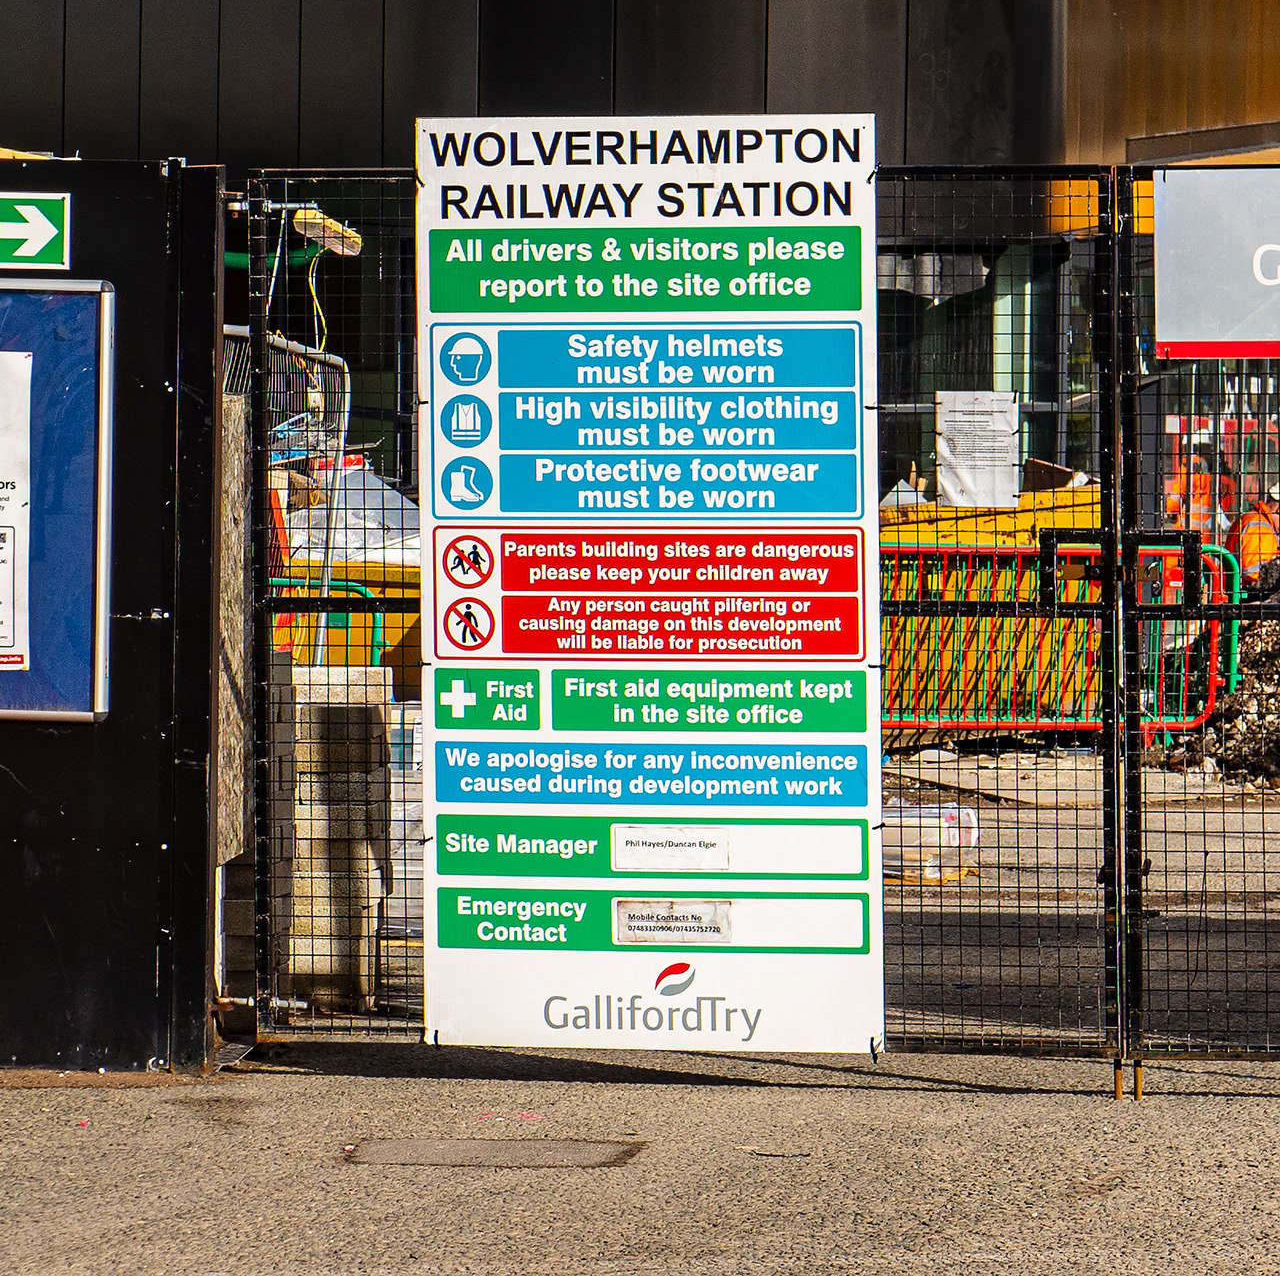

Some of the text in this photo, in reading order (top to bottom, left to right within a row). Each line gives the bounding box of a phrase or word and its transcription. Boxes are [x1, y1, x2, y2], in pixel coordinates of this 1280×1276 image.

[430, 128, 862, 167] WOLVERHAMPTON
[441, 181, 852, 220] RAILWAY STATION
[446, 238, 845, 266] All drivers & visitors please
[479, 274, 811, 302] report to the site office
[568, 334, 783, 363] Safety helmets
[577, 361, 775, 384] must be worn
[516, 396, 838, 425] High visibility clothing
[578, 424, 776, 446] must be worn
[536, 458, 819, 483] Protective footwear
[578, 486, 776, 508] must be worn
[505, 541, 854, 564] Parents building sites are dangerous
[529, 565, 829, 586] please keep your children away
[548, 597, 811, 617] Any person caught pilfering or
[519, 616, 841, 635] causing damage on this development
[557, 634, 802, 654] will be liable for prosecution
[486, 680, 533, 699] First
[565, 679, 853, 704] First aid equipment kept
[492, 704, 527, 722] Aid
[614, 704, 803, 724] in the site office
[445, 747, 858, 774] We apologise for any inconvenience
[460, 774, 843, 798] caused during development work
[445, 833, 598, 859] Site Manager
[457, 896, 587, 922] Emergency
[476, 922, 567, 943] Contact
